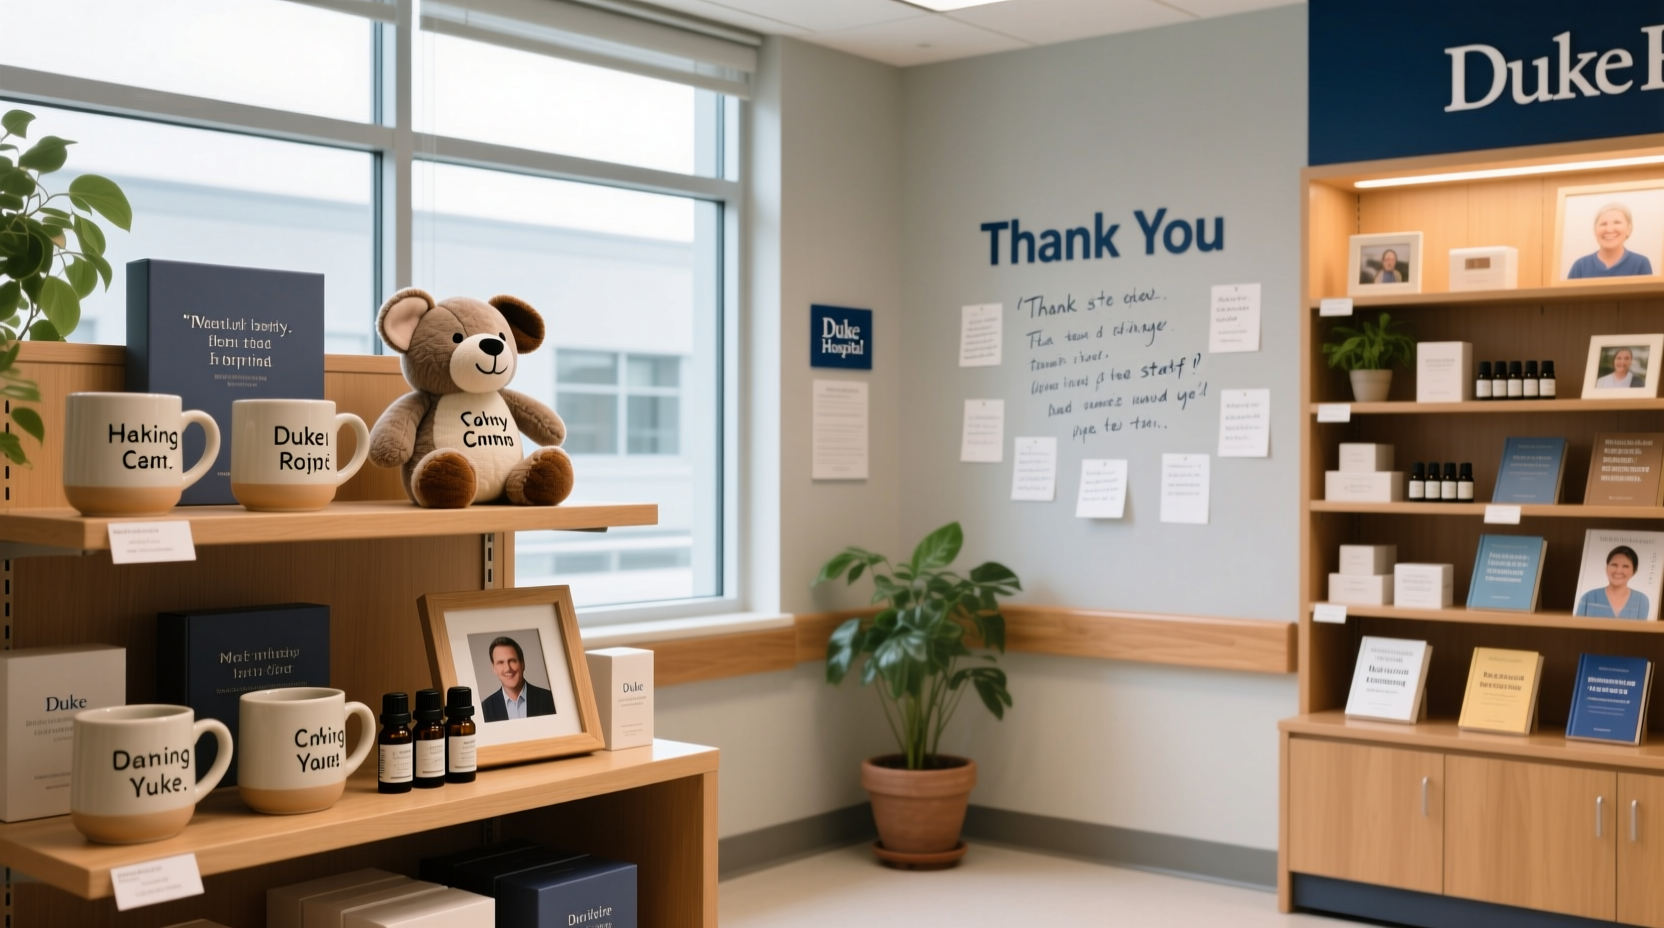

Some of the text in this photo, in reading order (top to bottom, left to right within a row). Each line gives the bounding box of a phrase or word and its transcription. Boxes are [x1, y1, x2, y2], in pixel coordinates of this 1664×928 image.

[1444, 31, 1634, 113] Duke
[980, 207, 1224, 266] Thank You
[822, 316, 861, 340] Duke
[821, 338, 865, 359] Hospital
[108, 422, 178, 451] Haking
[45, 693, 88, 712] Duke
[129, 773, 187, 798] Yuke.
